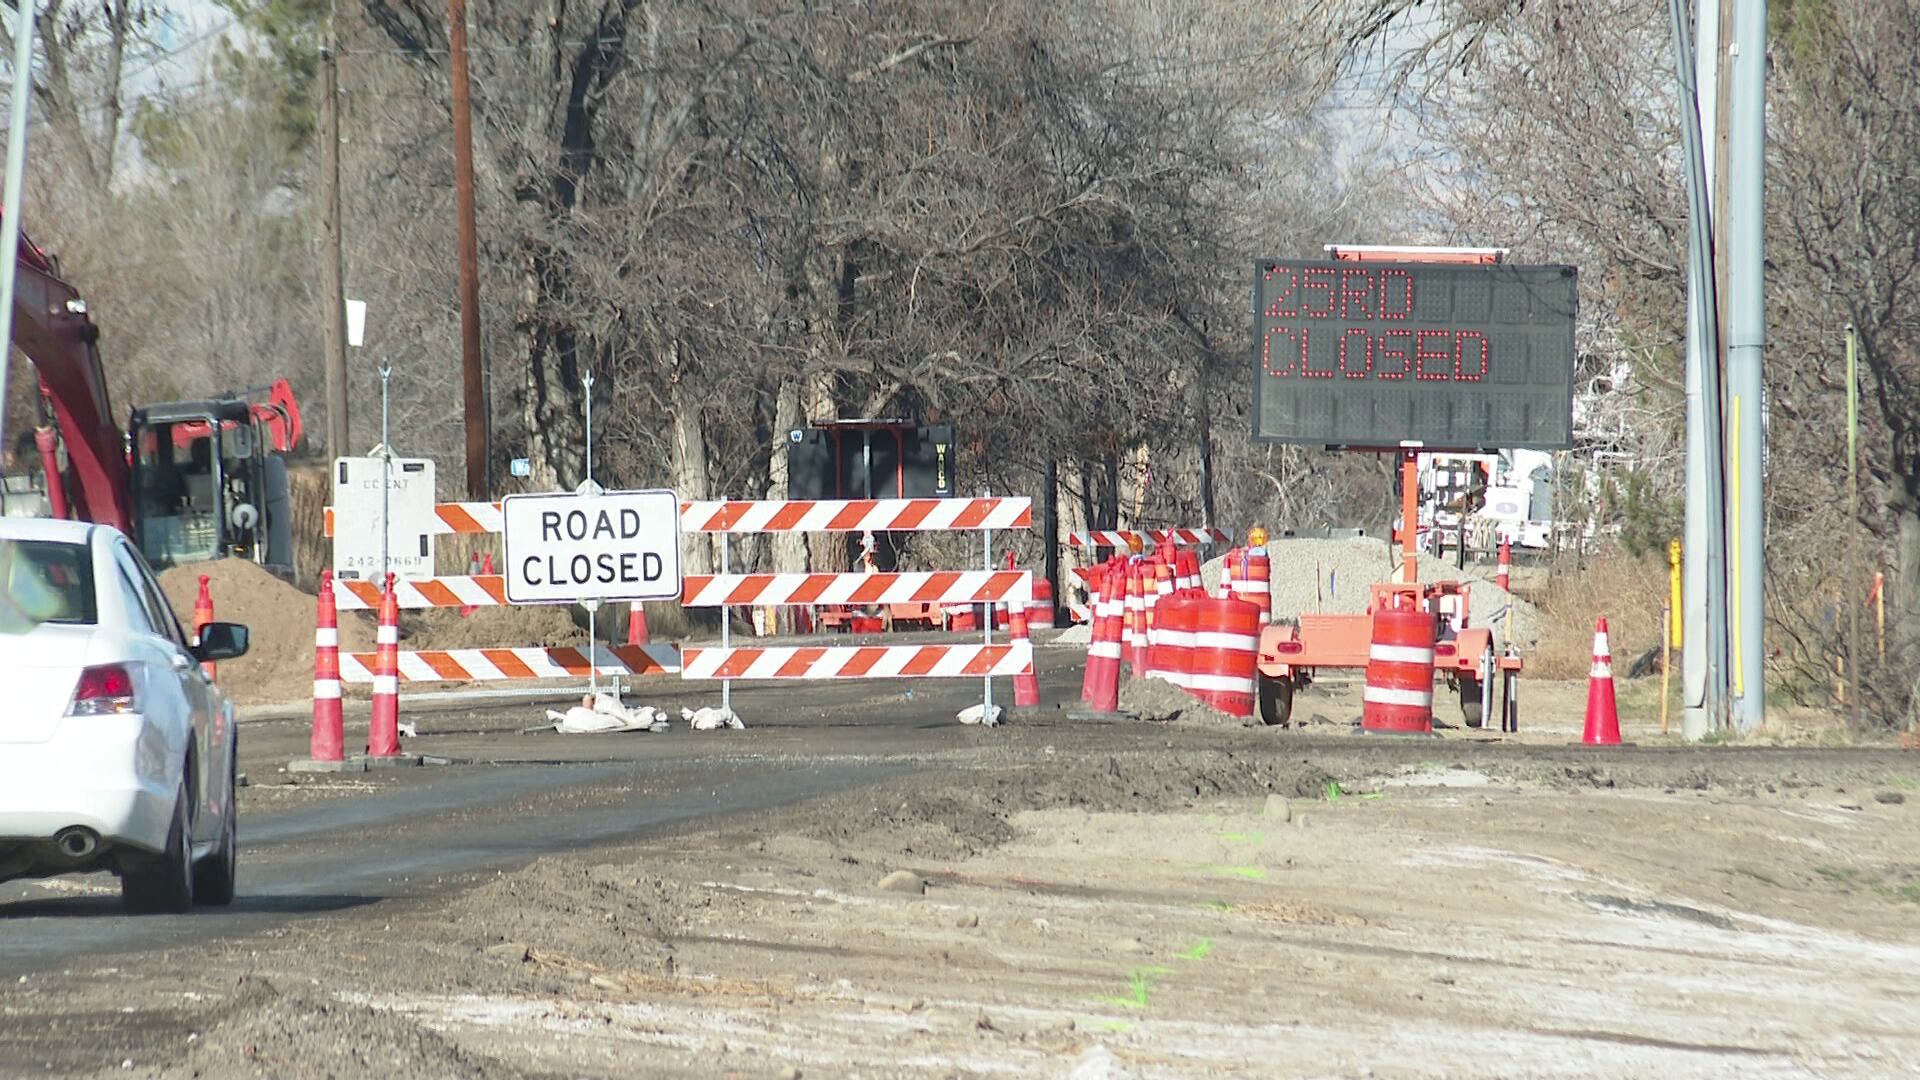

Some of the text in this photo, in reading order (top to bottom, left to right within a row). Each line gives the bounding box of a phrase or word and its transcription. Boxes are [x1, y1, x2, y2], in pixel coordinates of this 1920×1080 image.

[1264, 267, 1414, 320] 25RD
[1263, 327, 1490, 382] CLOSED
[542, 509, 641, 542] ROAD
[522, 552, 664, 586] CLOSED
